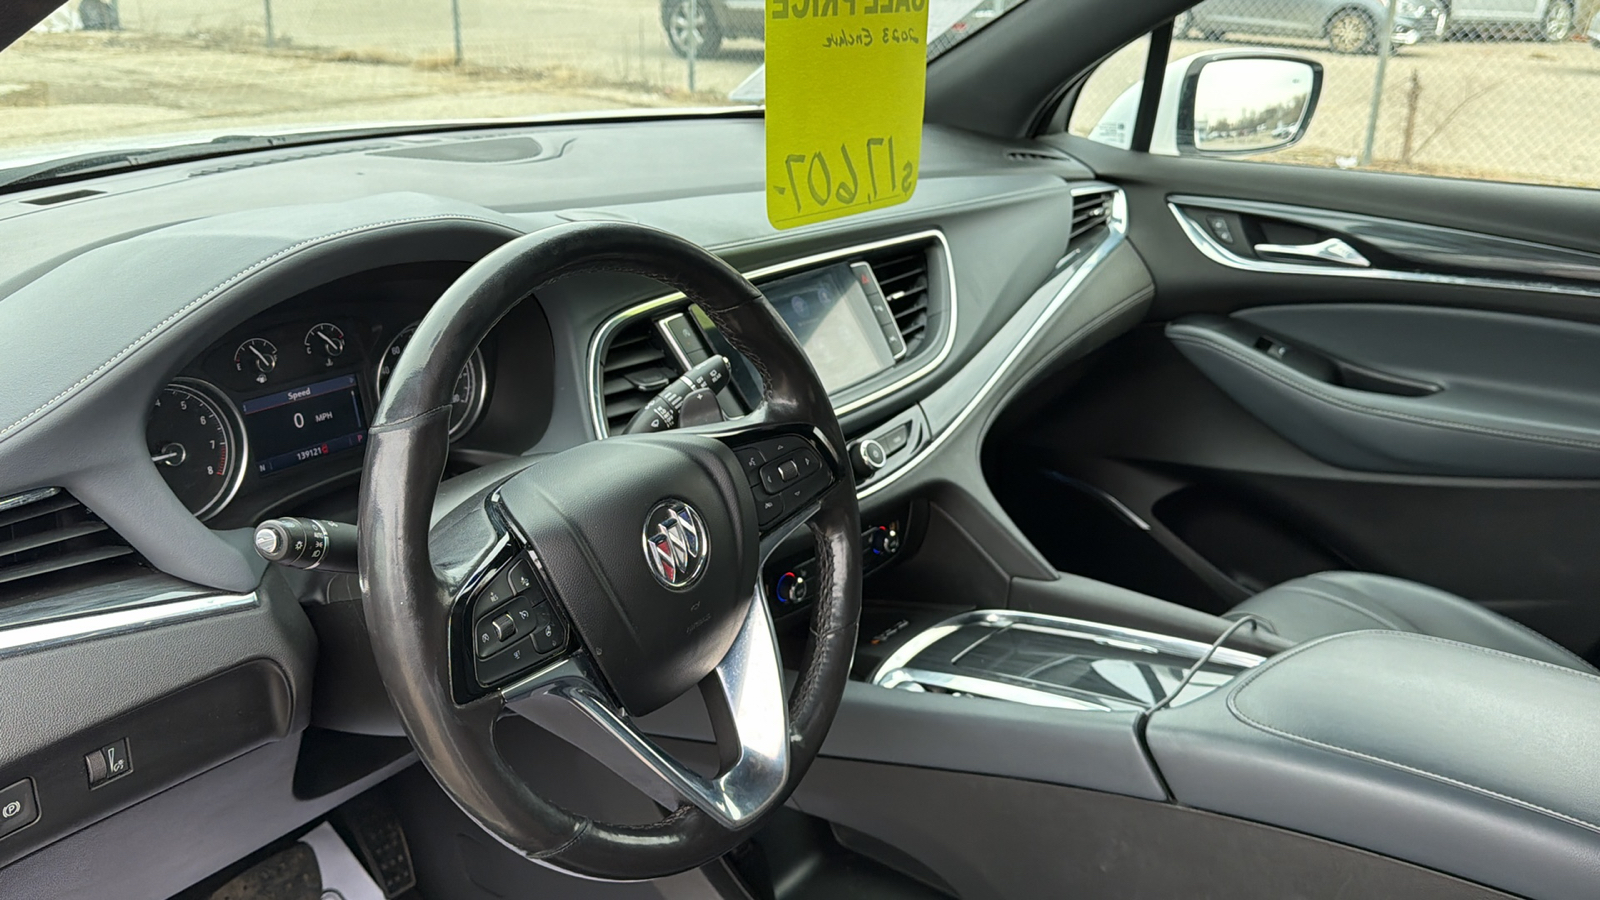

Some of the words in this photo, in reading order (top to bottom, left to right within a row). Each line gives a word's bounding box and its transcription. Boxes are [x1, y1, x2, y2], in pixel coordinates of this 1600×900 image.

[287, 386, 312, 401] Speed
[180, 400, 188, 410] 5
[199, 415, 207, 426] 6
[293, 412, 305, 428] 0
[315, 411, 334, 423] MPH
[209, 439, 216, 450] 7
[296, 446, 322, 461] 139121
[206, 465, 214, 476] 8
[259, 463, 266, 473] N
